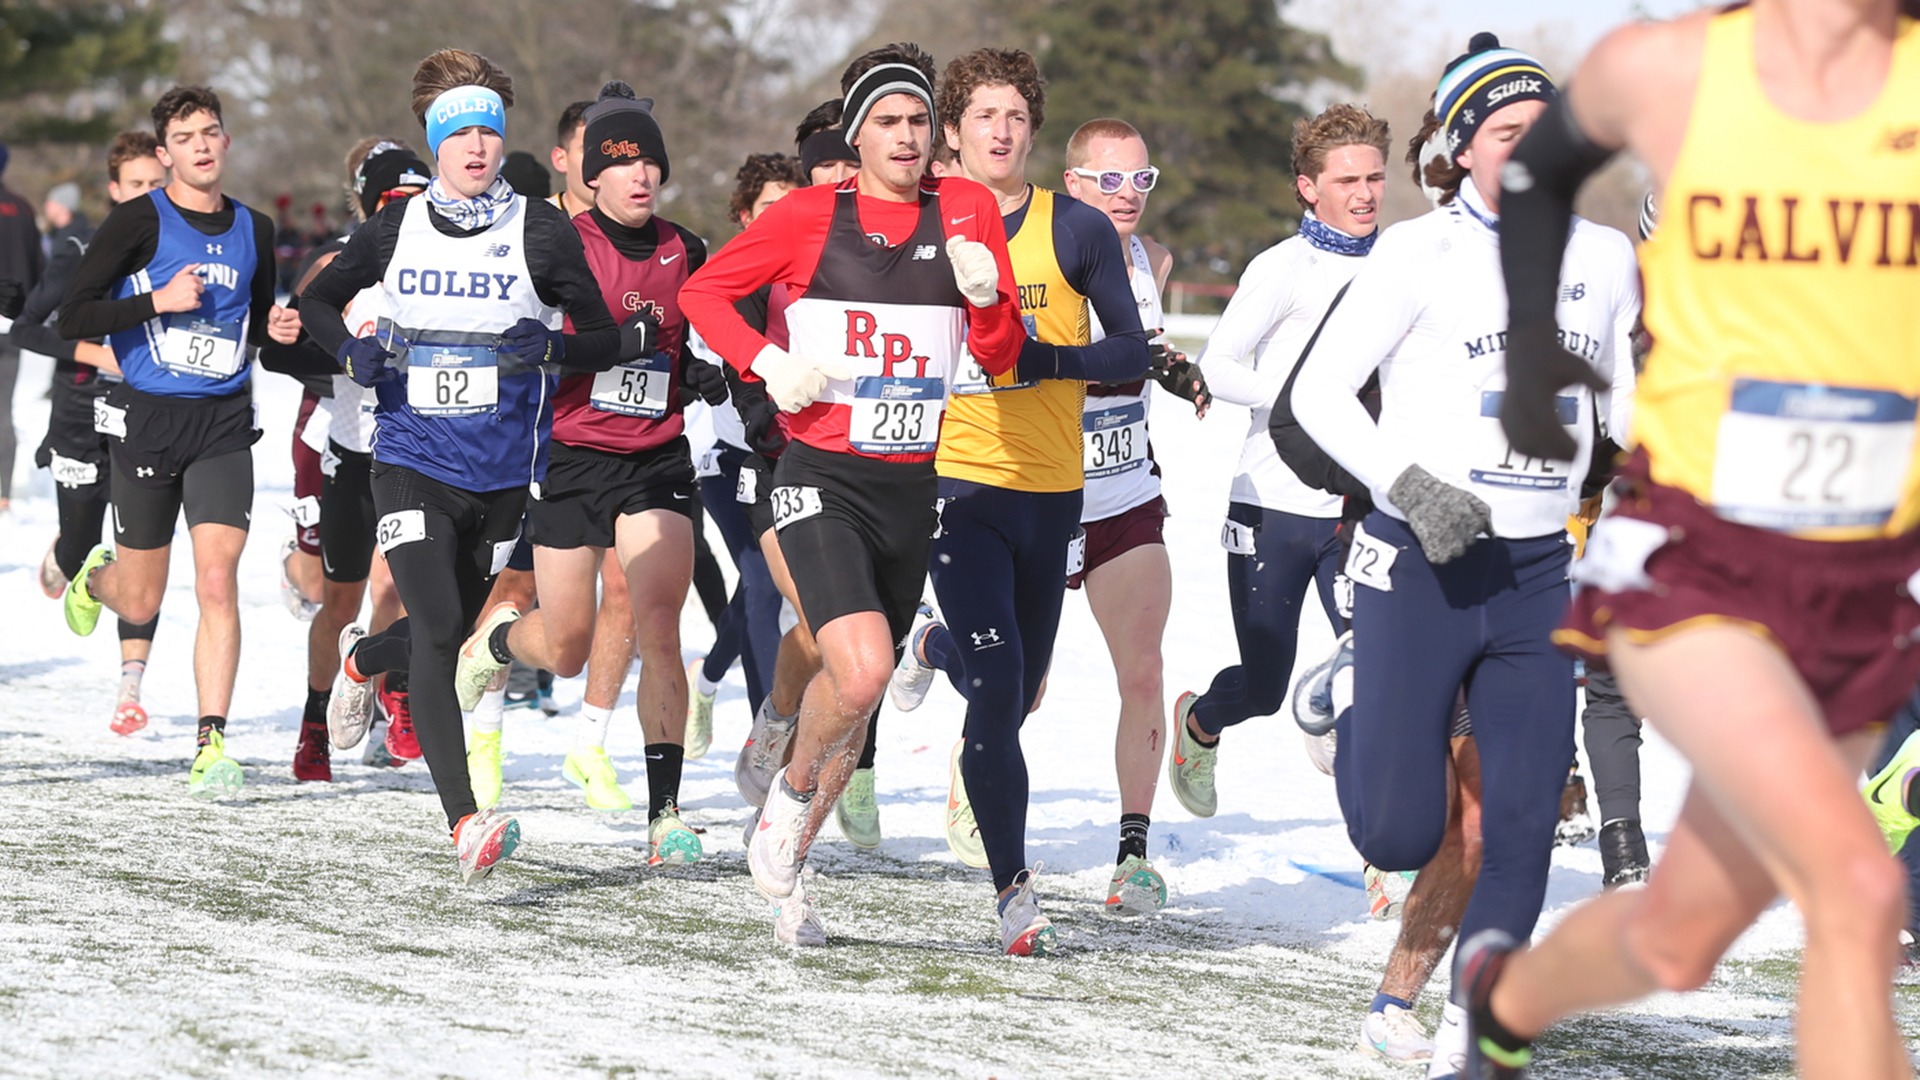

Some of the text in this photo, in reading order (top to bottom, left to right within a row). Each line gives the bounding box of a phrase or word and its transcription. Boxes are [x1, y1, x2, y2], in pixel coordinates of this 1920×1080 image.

[436, 97, 500, 125] COLBY
[398, 267, 519, 301] COLBY
[186, 335, 216, 368] 52
[436, 369, 469, 405] 62
[617, 369, 649, 405] 53
[871, 401, 925, 442] 233
[1091, 426, 1132, 468] 343
[1781, 430, 1855, 502] 22
[772, 487, 804, 523] 233
[380, 518, 403, 545] 62
[1352, 540, 1379, 578] 72
